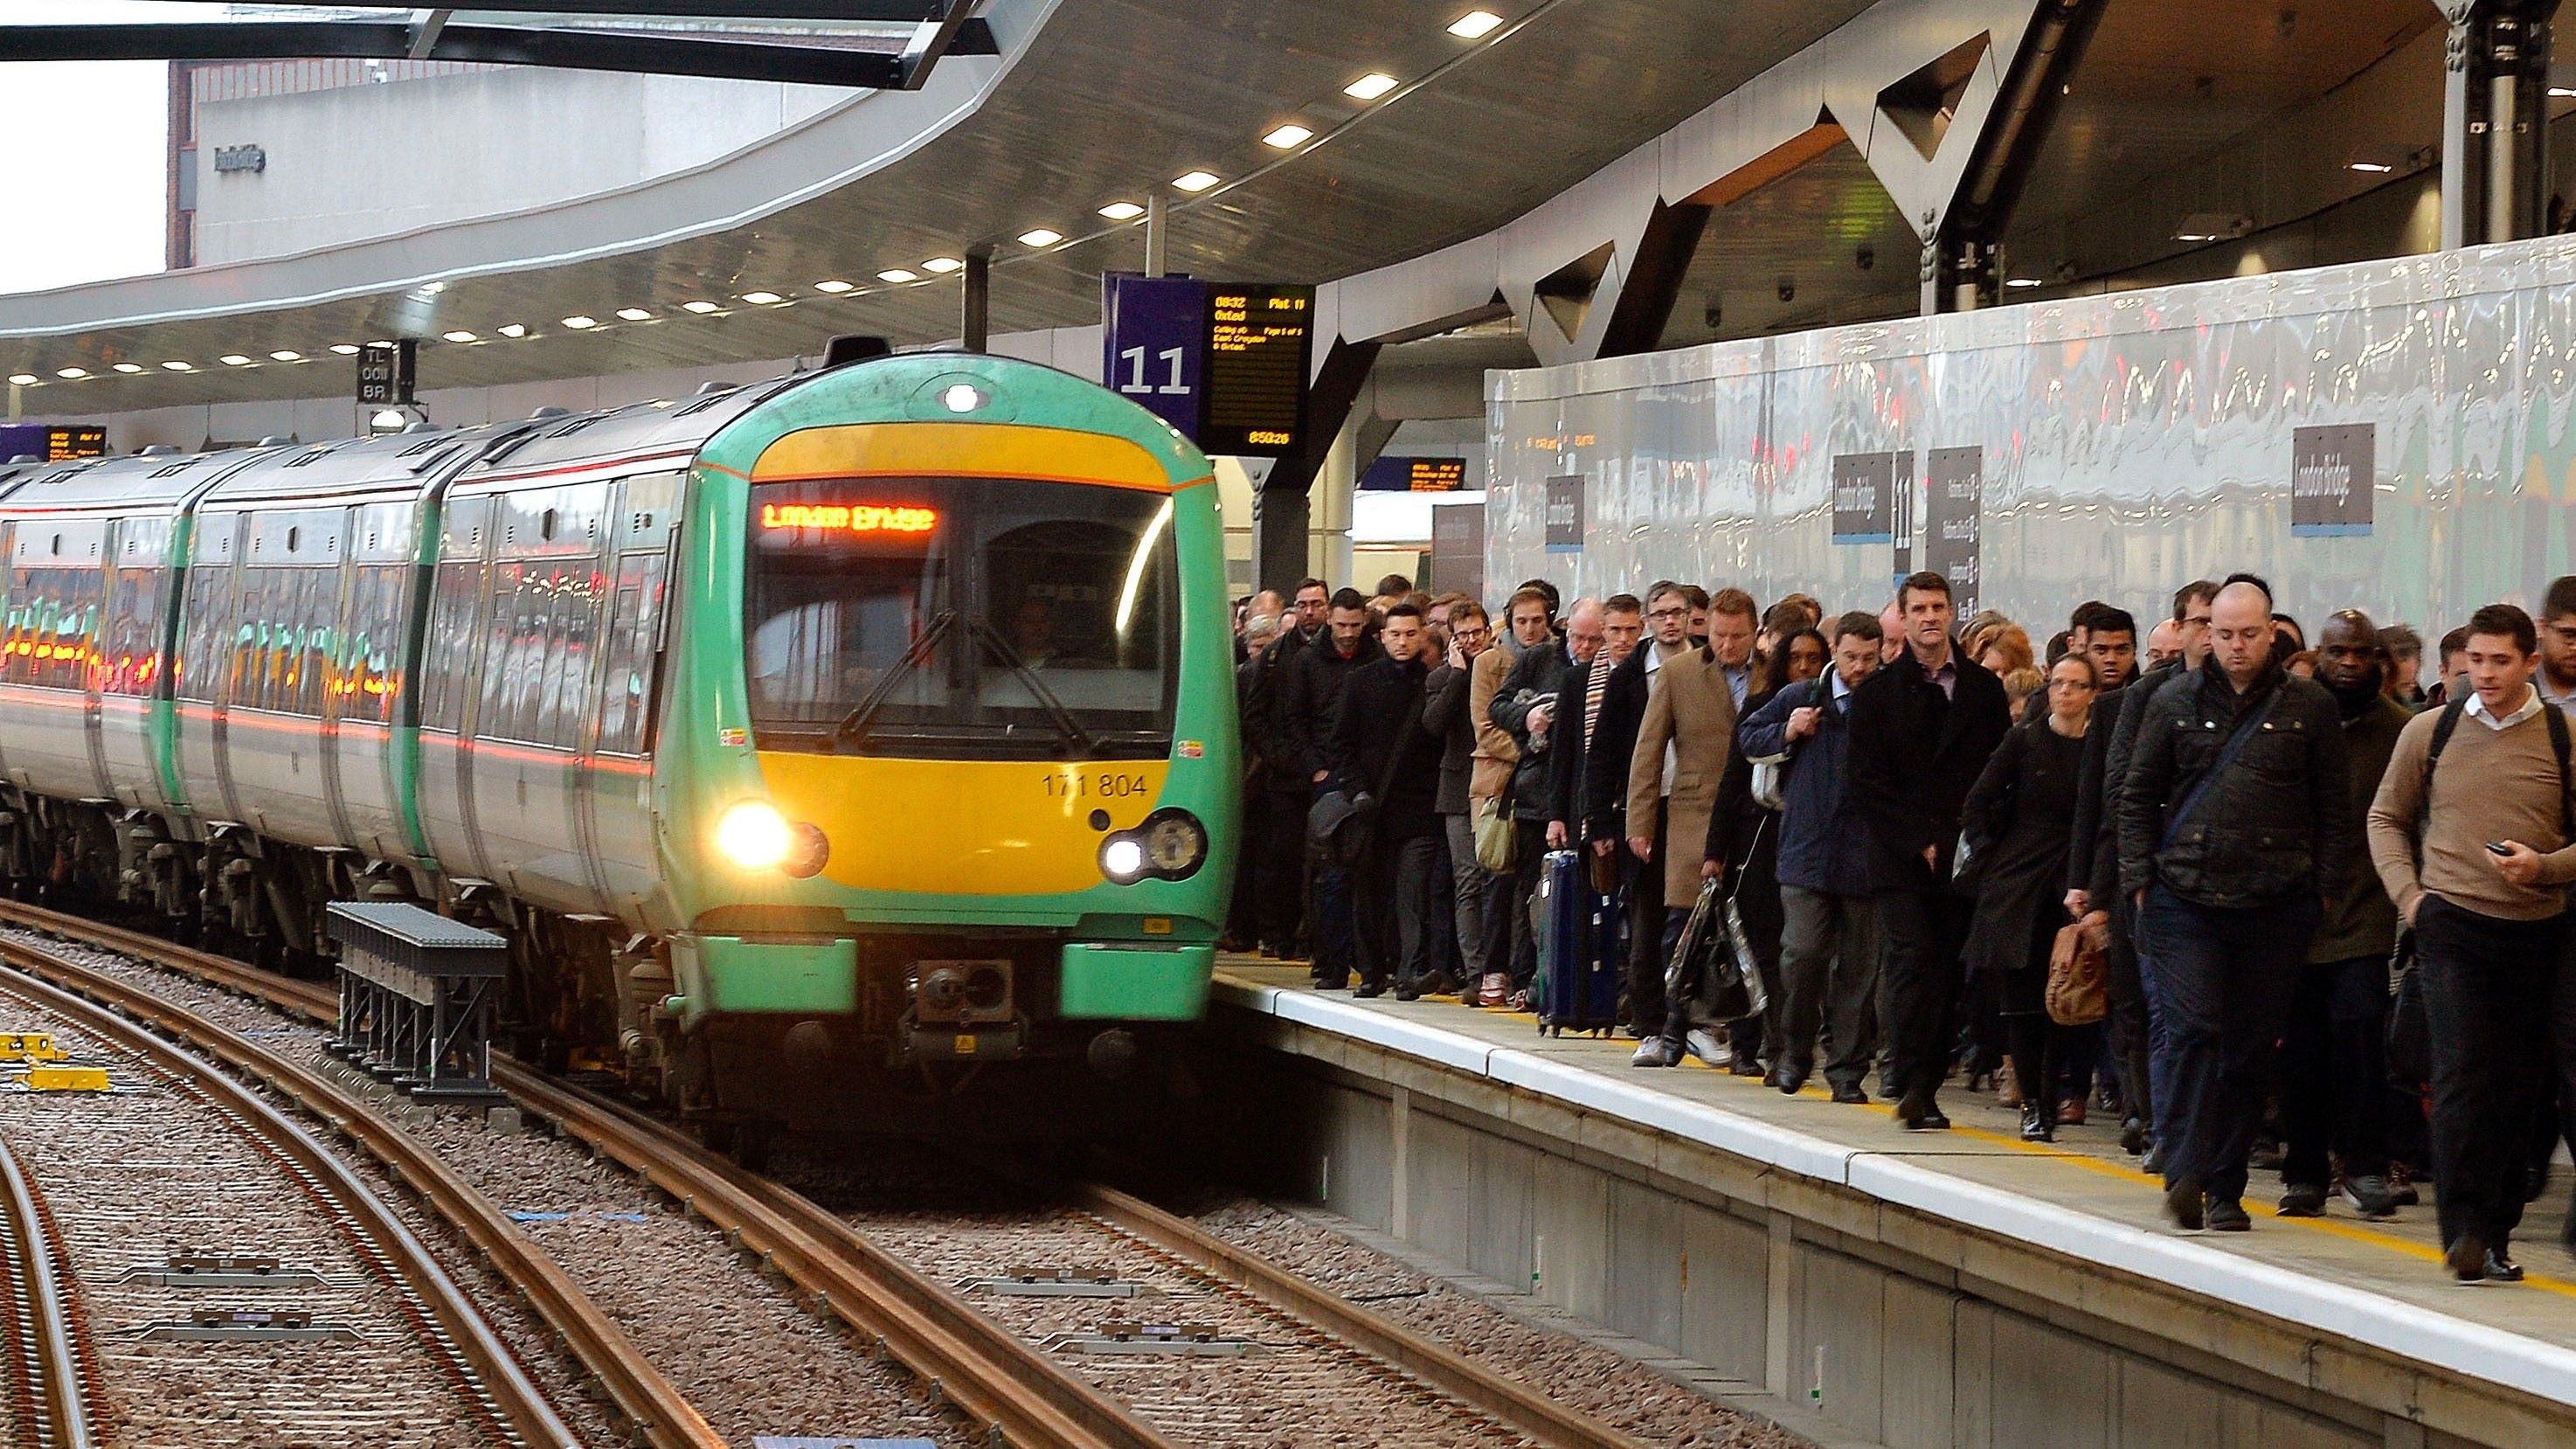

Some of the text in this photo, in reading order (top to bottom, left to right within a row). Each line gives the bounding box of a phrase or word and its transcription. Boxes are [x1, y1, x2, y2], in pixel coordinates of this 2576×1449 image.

[1269, 298, 1291, 309] Plat
[1214, 309, 1246, 321] Oxted
[366, 350, 385, 363] TL
[1121, 346, 1190, 394] 11
[364, 385, 385, 399] BR
[764, 504, 935, 531] London Bridge
[1896, 476, 1911, 549] 11
[1042, 774, 1147, 797] 171 804
